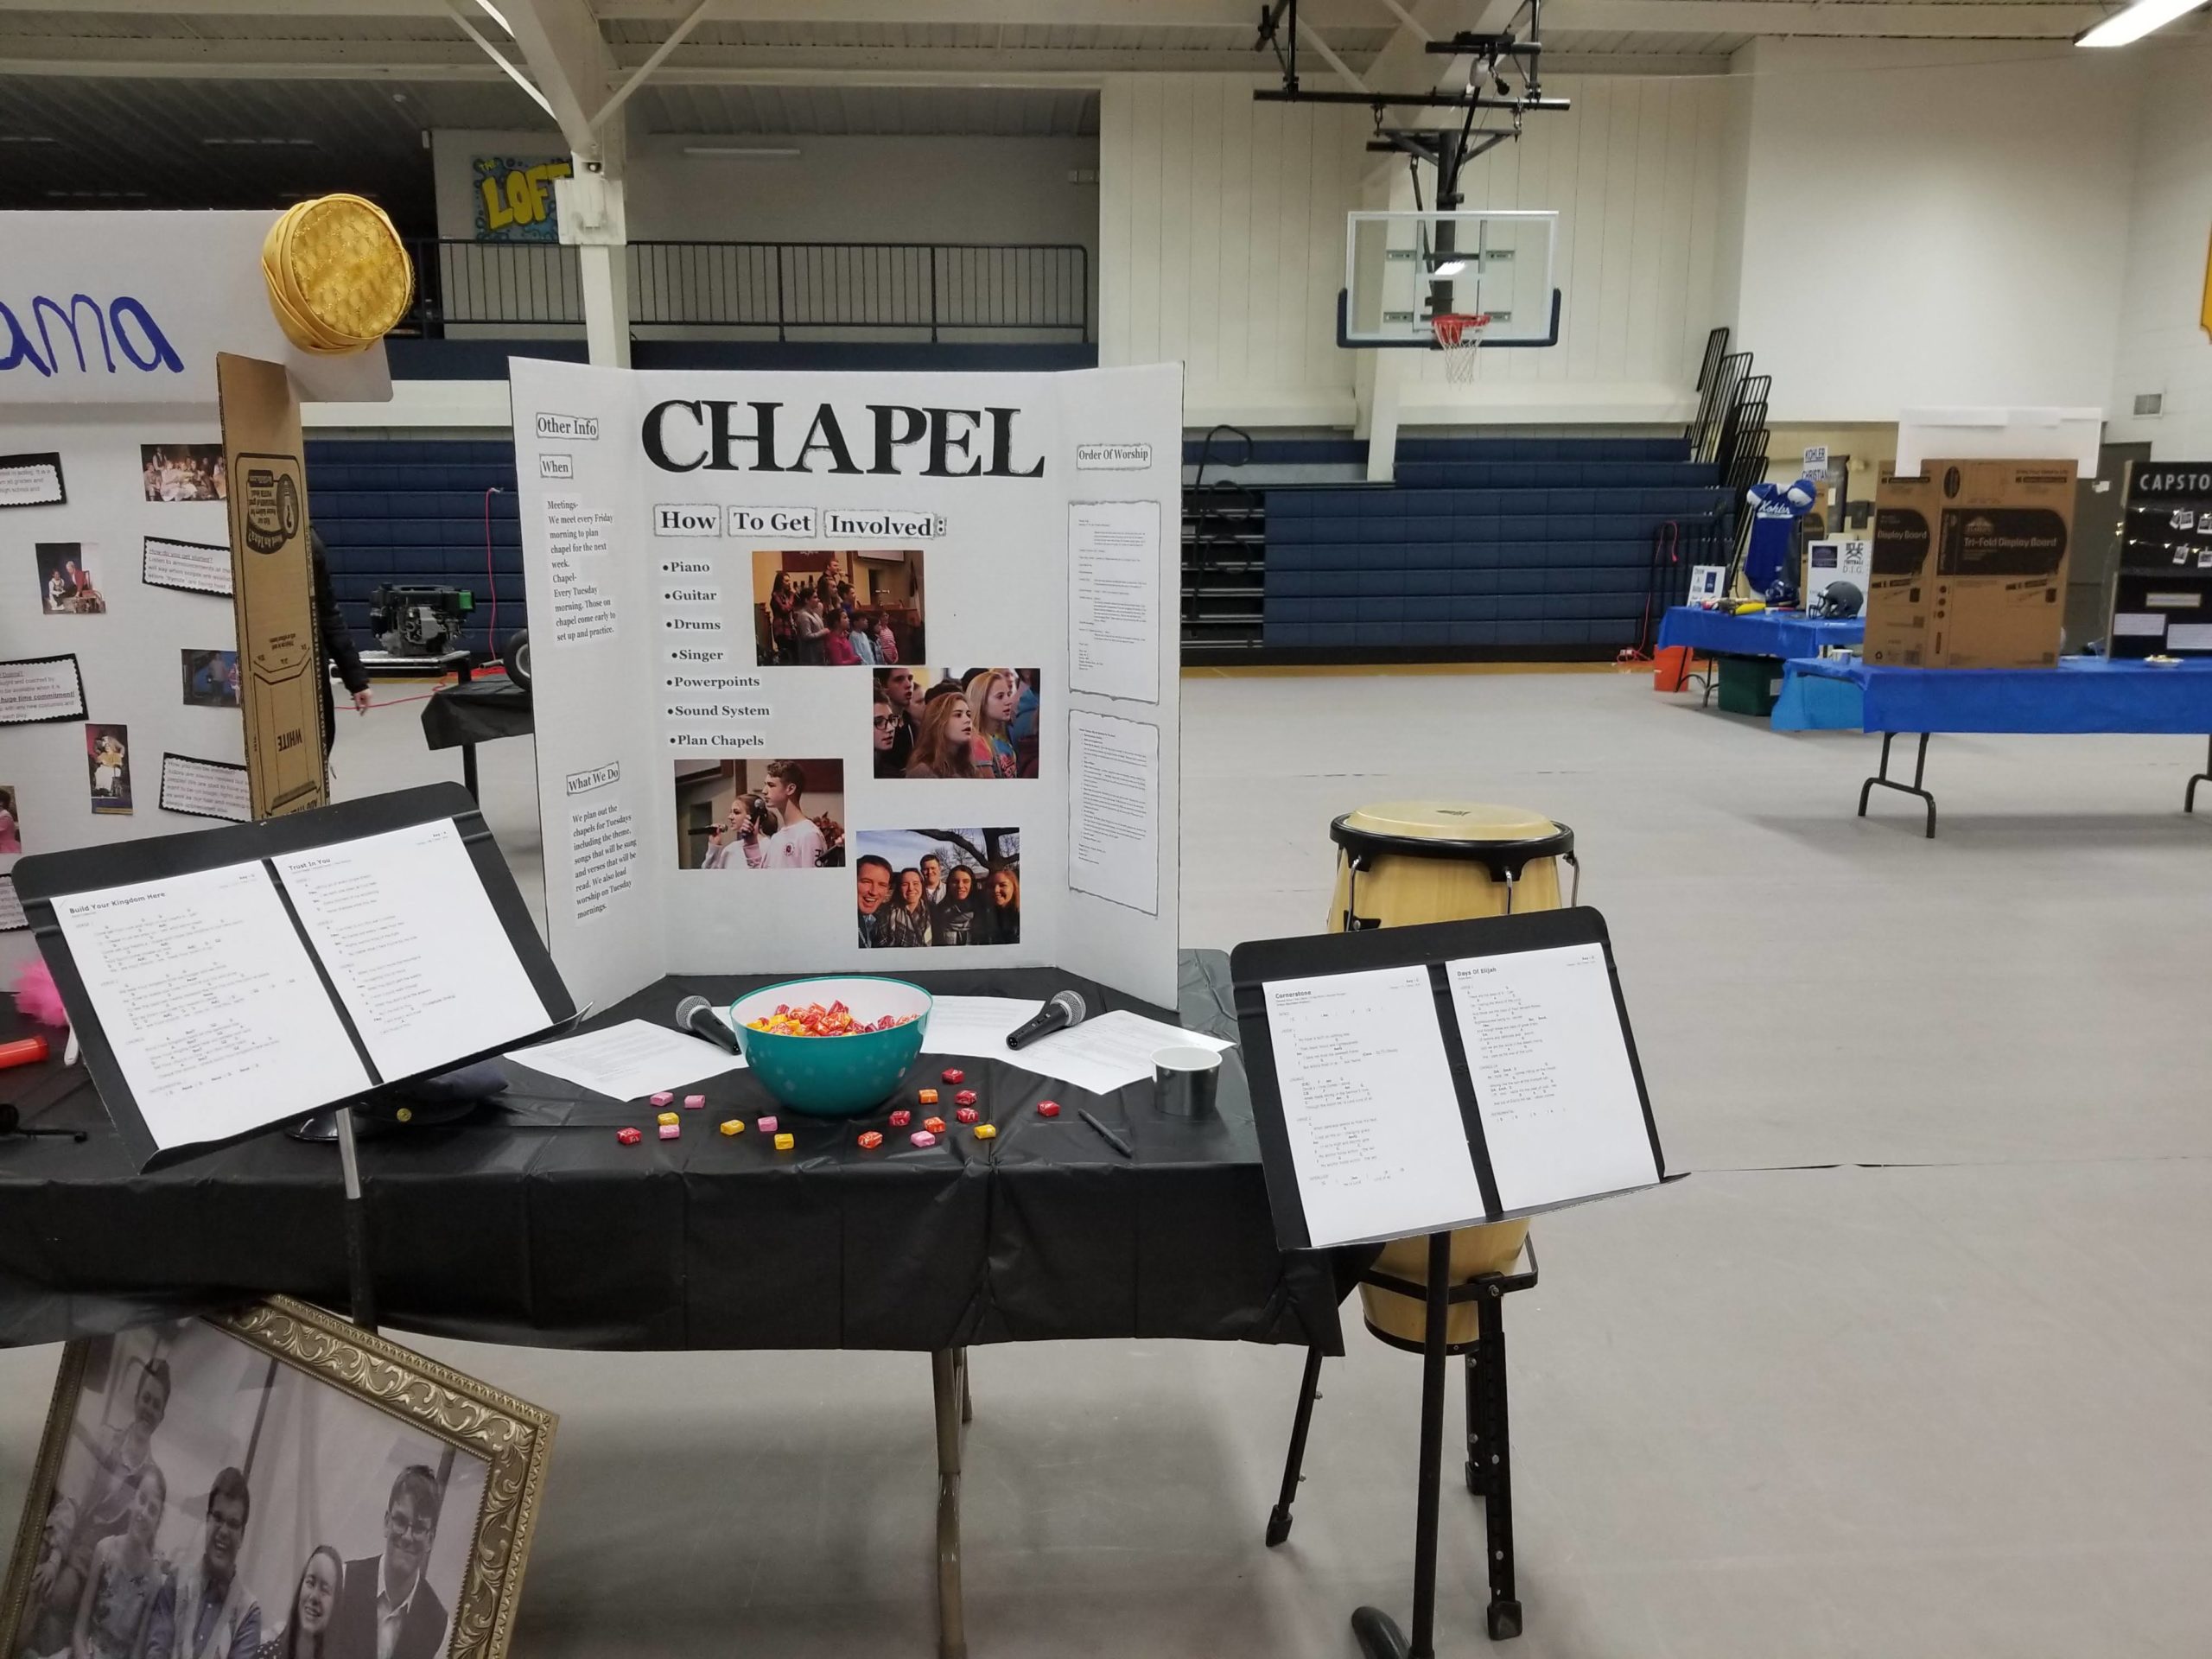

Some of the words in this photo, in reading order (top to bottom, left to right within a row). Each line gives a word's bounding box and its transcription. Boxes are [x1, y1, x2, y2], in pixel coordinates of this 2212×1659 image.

[538, 416, 571, 434] Other
[574, 420, 596, 435] Info
[642, 399, 1045, 478] CHAPEL
[1079, 449, 1102, 460] Order
[1103, 449, 1113, 460] Of
[1115, 448, 1148, 461] Worship
[543, 461, 569, 473] When
[2139, 474, 2211, 491] CAPSTO
[547, 500, 578, 511] Meetings-
[1758, 500, 1790, 515] Kohler
[548, 516, 559, 524] We
[577, 516, 593, 524] every
[594, 513, 613, 524] Friday
[660, 511, 716, 530] How
[734, 512, 764, 531] To
[771, 512, 811, 531] Get
[550, 529, 577, 539] morning
[585, 528, 599, 539] plan
[551, 543, 571, 555] chapel
[573, 543, 582, 552] for
[583, 543, 593, 551] the
[1964, 537, 1997, 547] Tri-Fold
[1999, 537, 2029, 548] Display
[2031, 537, 2056, 547] Board
[552, 559, 569, 569] week.
[671, 562, 710, 572] Piano
[553, 573, 577, 584] Chapel-
[554, 589, 571, 598] Every
[573, 585, 597, 595] Tuesday
[672, 590, 717, 601] Guitar
[555, 601, 584, 612] morning.
[584, 600, 602, 608] Those
[556, 616, 576, 627] chapel
[594, 612, 608, 621] early
[674, 619, 721, 630] Drums
[577, 628, 588, 638] and
[589, 626, 614, 639] practice.
[679, 650, 723, 662] Singer
[674, 677, 760, 689] Powerpoints
[675, 705, 718, 715] Sound
[721, 706, 770, 718] System
[277, 728, 302, 752] WHITE
[677, 734, 708, 745] Plan
[711, 735, 764, 747] Chapels
[569, 777, 591, 791] What
[593, 772, 606, 784] We
[607, 769, 619, 779] Do
[572, 814, 582, 823] We
[584, 811, 596, 822] plan
[598, 807, 607, 817] out
[608, 804, 617, 813] the
[573, 824, 595, 836] chapels
[596, 822, 606, 830] for
[606, 815, 632, 827] Tuesdays
[574, 837, 601, 851] including
[602, 833, 612, 842] the
[612, 829, 632, 838] theme,
[574, 854, 591, 864] songs
[592, 849, 604, 859] that
[605, 844, 615, 855] will
[289, 862, 307, 871] Trust
[575, 867, 587, 878] and
[588, 863, 606, 874] verses
[607, 858, 618, 868] that
[619, 853, 629, 863] will
[575, 880, 591, 892] read.
[592, 877, 602, 886] We
[602, 873, 614, 882] also
[615, 867, 626, 878] lead
[576, 891, 601, 906] worship
[609, 880, 632, 893] Tuesday
[69, 905, 90, 914] Build
[92, 901, 110, 911] Your
[111, 895, 145, 908] Kingdom
[147, 892, 166, 900] Here
[577, 904, 607, 918] mornings.
[1275, 989, 1312, 1000] Cornerstone
